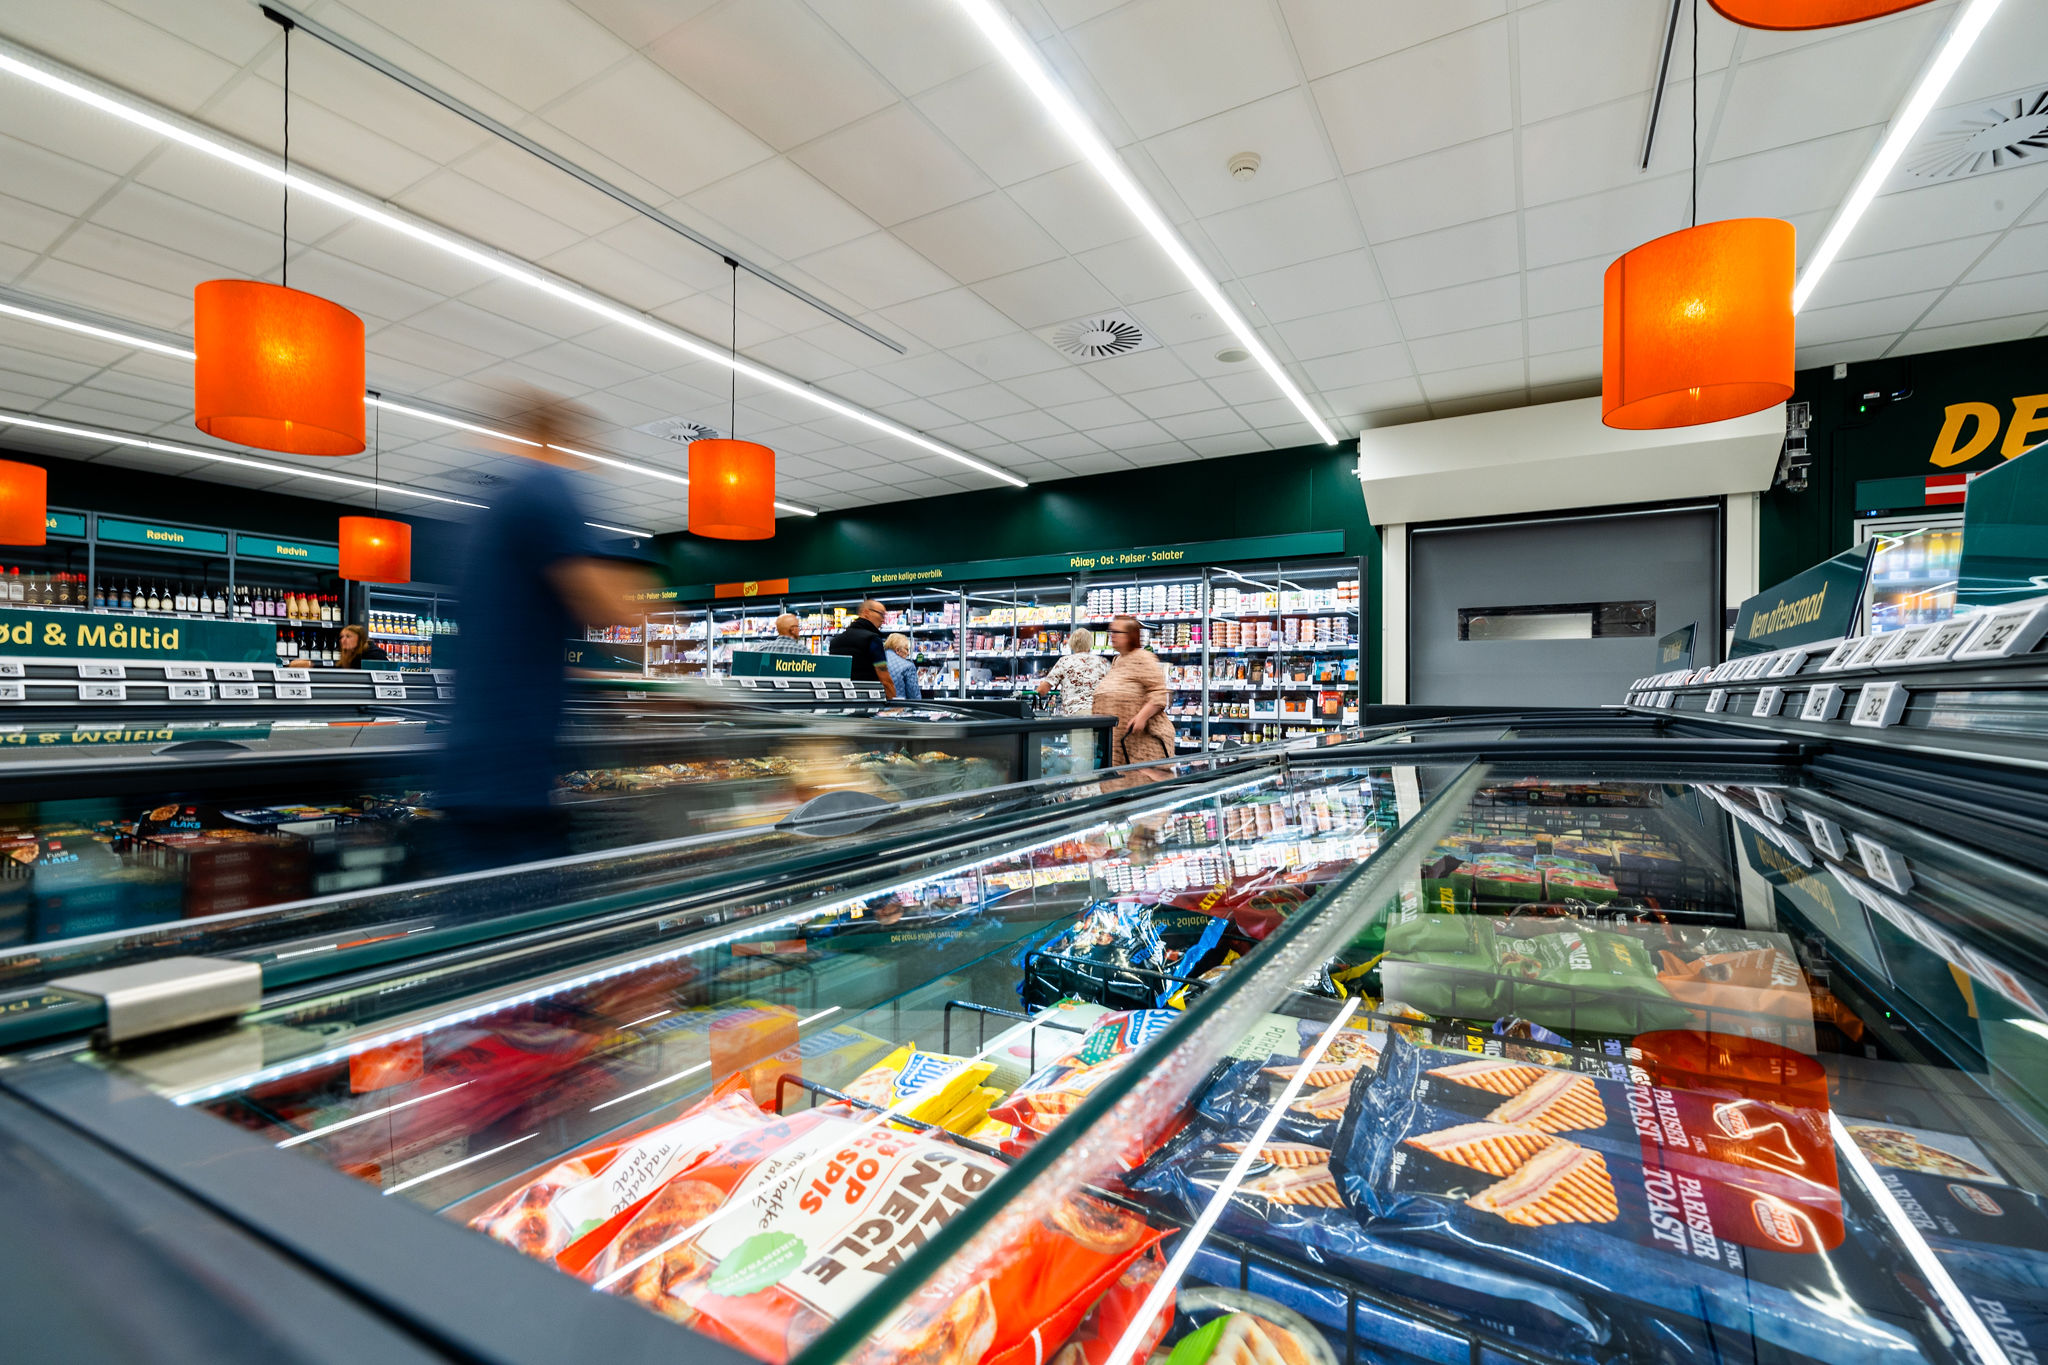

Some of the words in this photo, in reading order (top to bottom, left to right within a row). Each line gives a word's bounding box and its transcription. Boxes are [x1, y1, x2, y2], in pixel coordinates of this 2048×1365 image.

[1929, 393, 2048, 468] DE
[146, 529, 184, 543] Rødvin
[276, 545, 308, 557] Rødvin
[1070, 557, 1095, 568] Pålæg
[1100, 555, 1114, 565] Ost
[1120, 553, 1146, 564] Pølser
[1151, 550, 1184, 561] Salater
[871, 574, 882, 583] Det
[882, 574, 897, 582] store
[898, 572, 916, 582] kølige
[917, 569, 943, 579] overblik
[43, 623, 67, 646] &
[77, 622, 179, 650] Måltid
[1749, 610, 1766, 639] Nem
[1767, 581, 1828, 634] aftensmad
[775, 659, 817, 673] Kartofler
[1624, 1083, 1664, 1145] TOAST
[1653, 1088, 1689, 1148] PARISER
[610, 1143, 672, 1216] madpakke
[612, 1147, 648, 1194] parat
[799, 1149, 859, 1215] SPIS
[844, 1158, 880, 1205] OP
[801, 1151, 958, 1286] SNEGLE
[1642, 1167, 1689, 1255] TOAST
[1677, 1174, 1720, 1261] PARISER
[1880, 1173, 1939, 1231] PARISER
